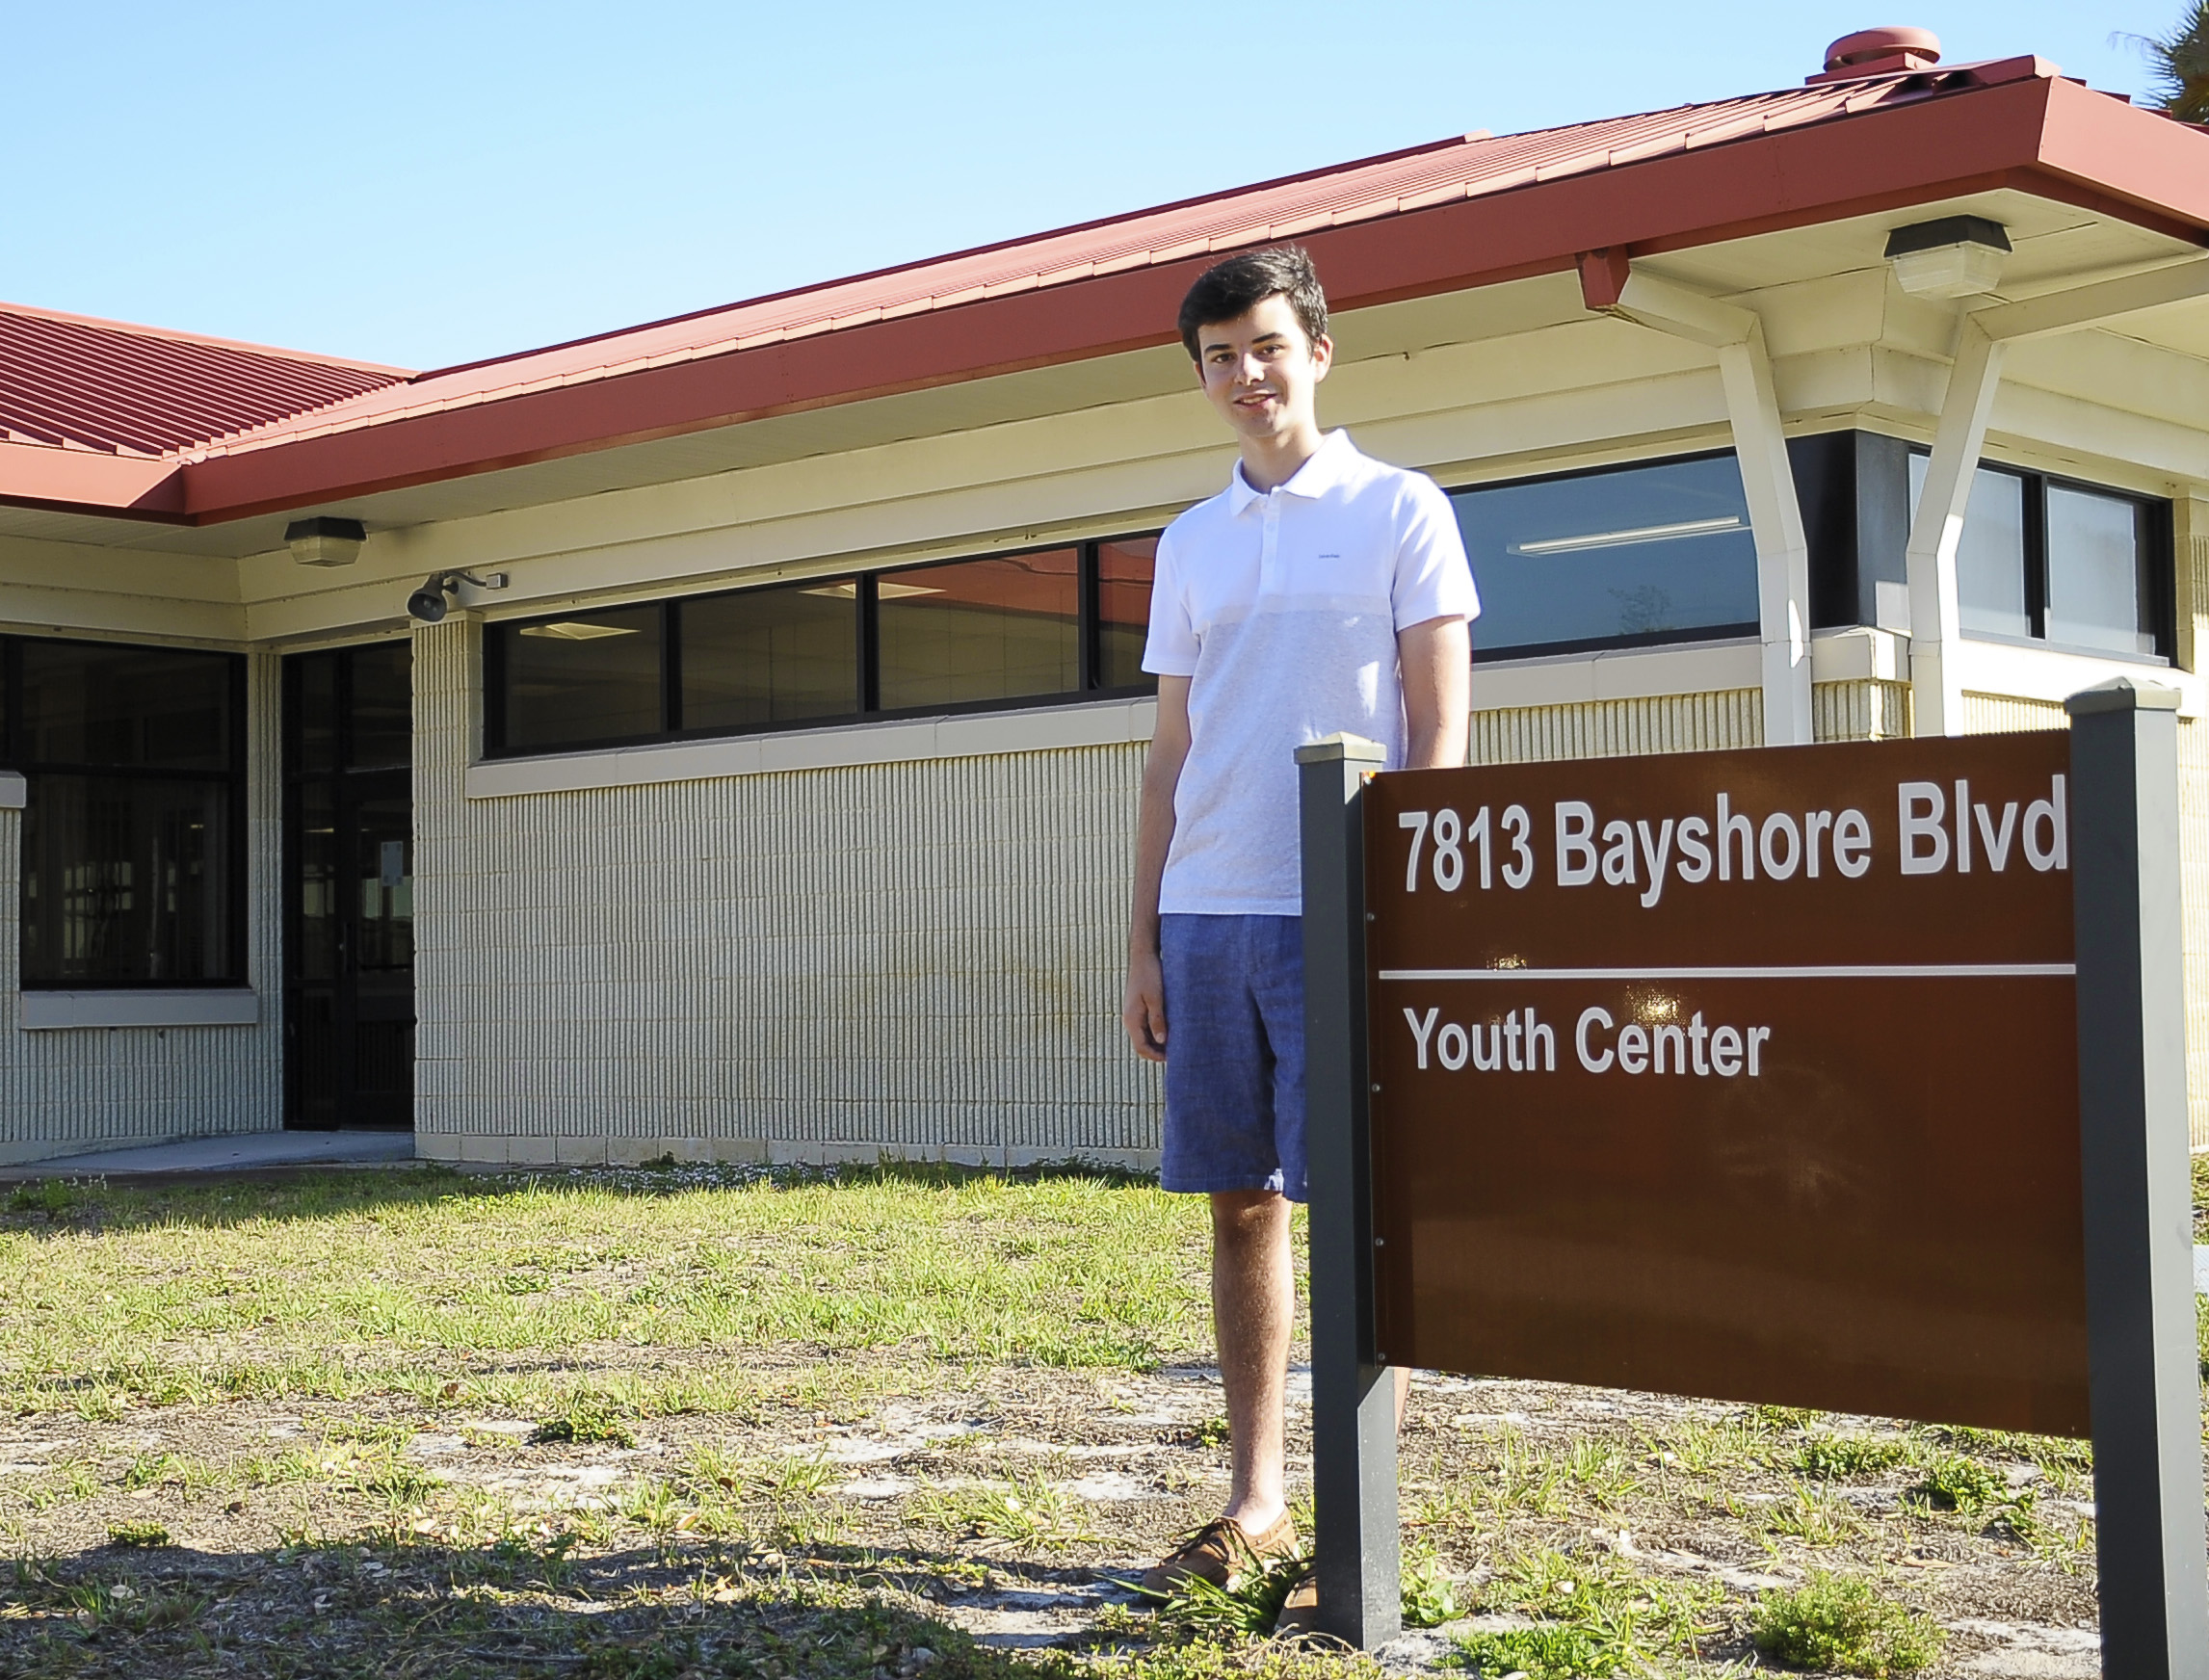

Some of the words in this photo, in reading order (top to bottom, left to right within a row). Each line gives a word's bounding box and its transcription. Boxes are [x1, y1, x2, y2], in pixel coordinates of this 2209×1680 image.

[1398, 803, 1534, 892] 7813
[1555, 792, 1872, 908] Bayshore
[1898, 774, 2068, 876] Blvd
[1403, 1007, 1556, 1072] Youth
[1575, 1006, 1771, 1077] Center
